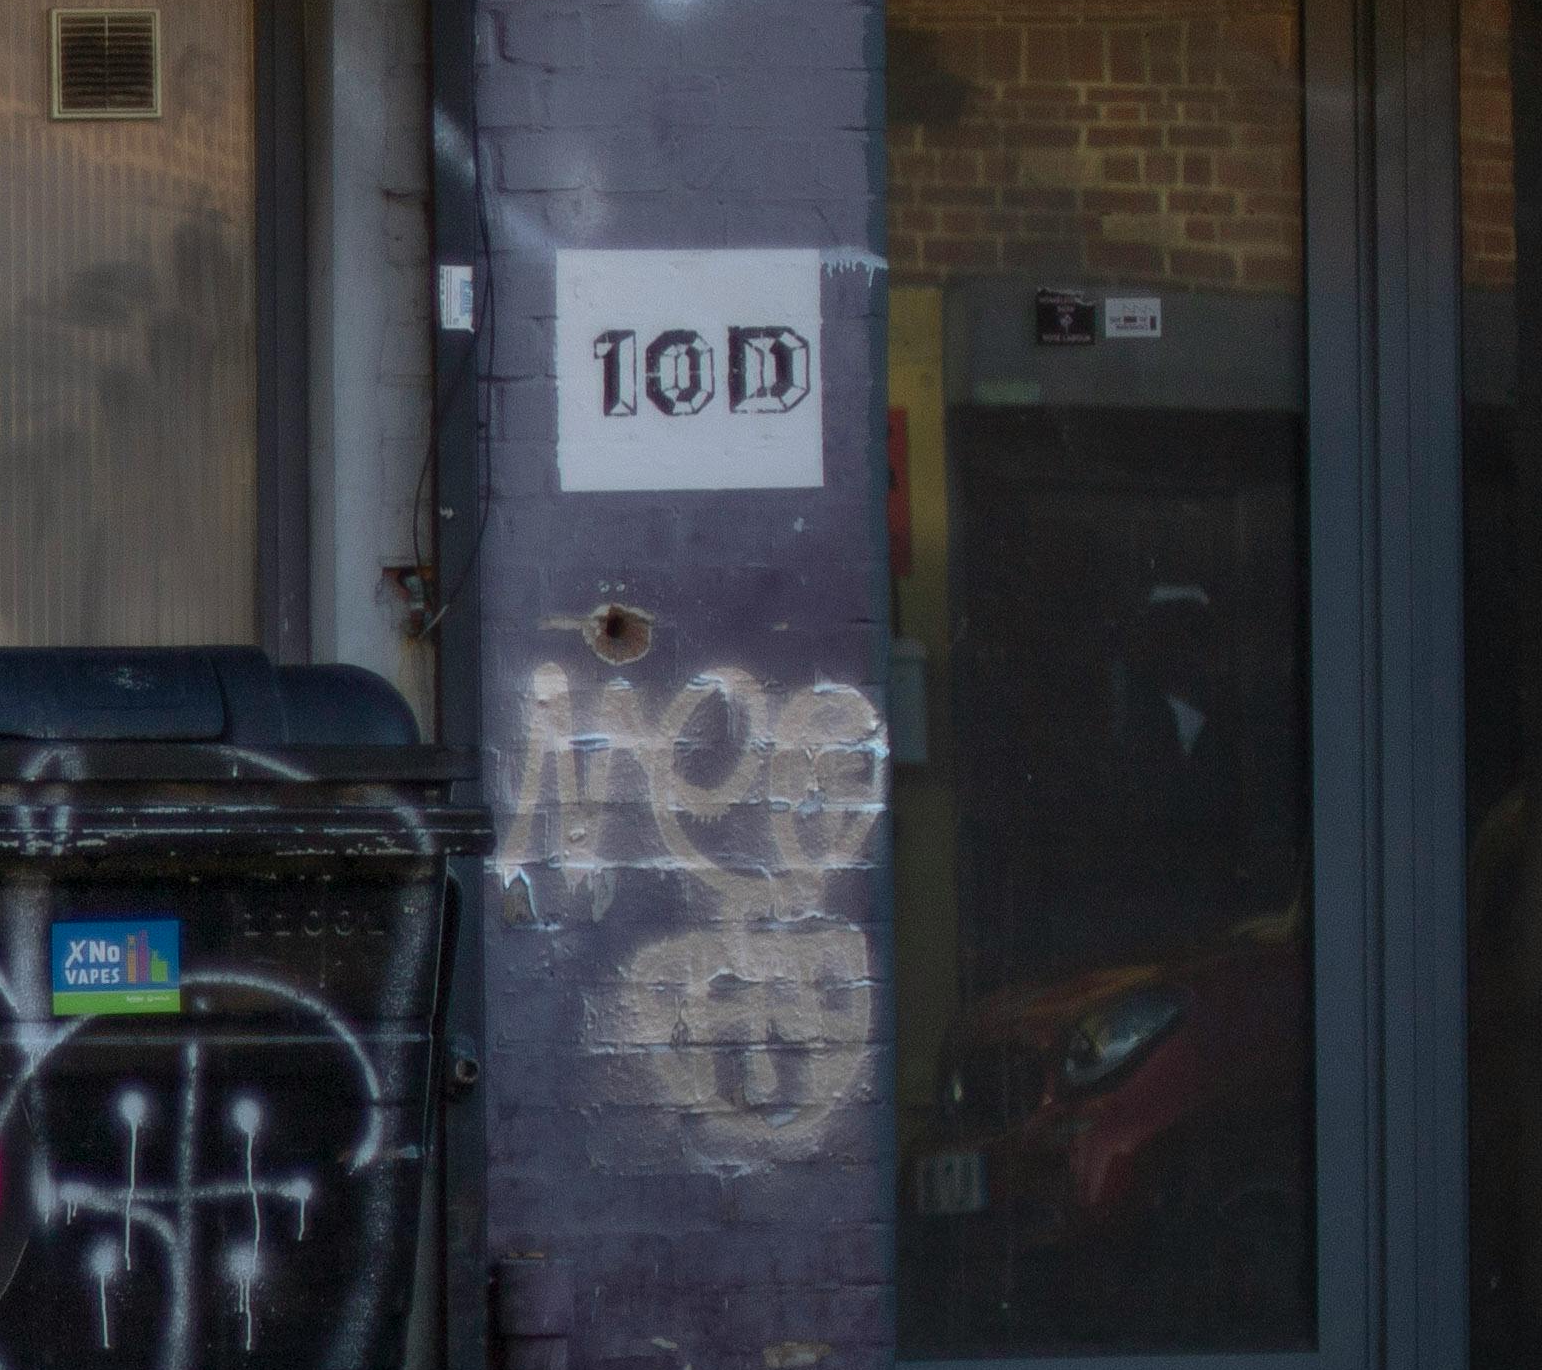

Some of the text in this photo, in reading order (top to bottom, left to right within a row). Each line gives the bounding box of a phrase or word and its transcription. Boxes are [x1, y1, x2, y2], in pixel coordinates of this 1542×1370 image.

[592, 325, 812, 417] 10D
[89, 940, 120, 963] No
[64, 968, 120, 985] VAPES
